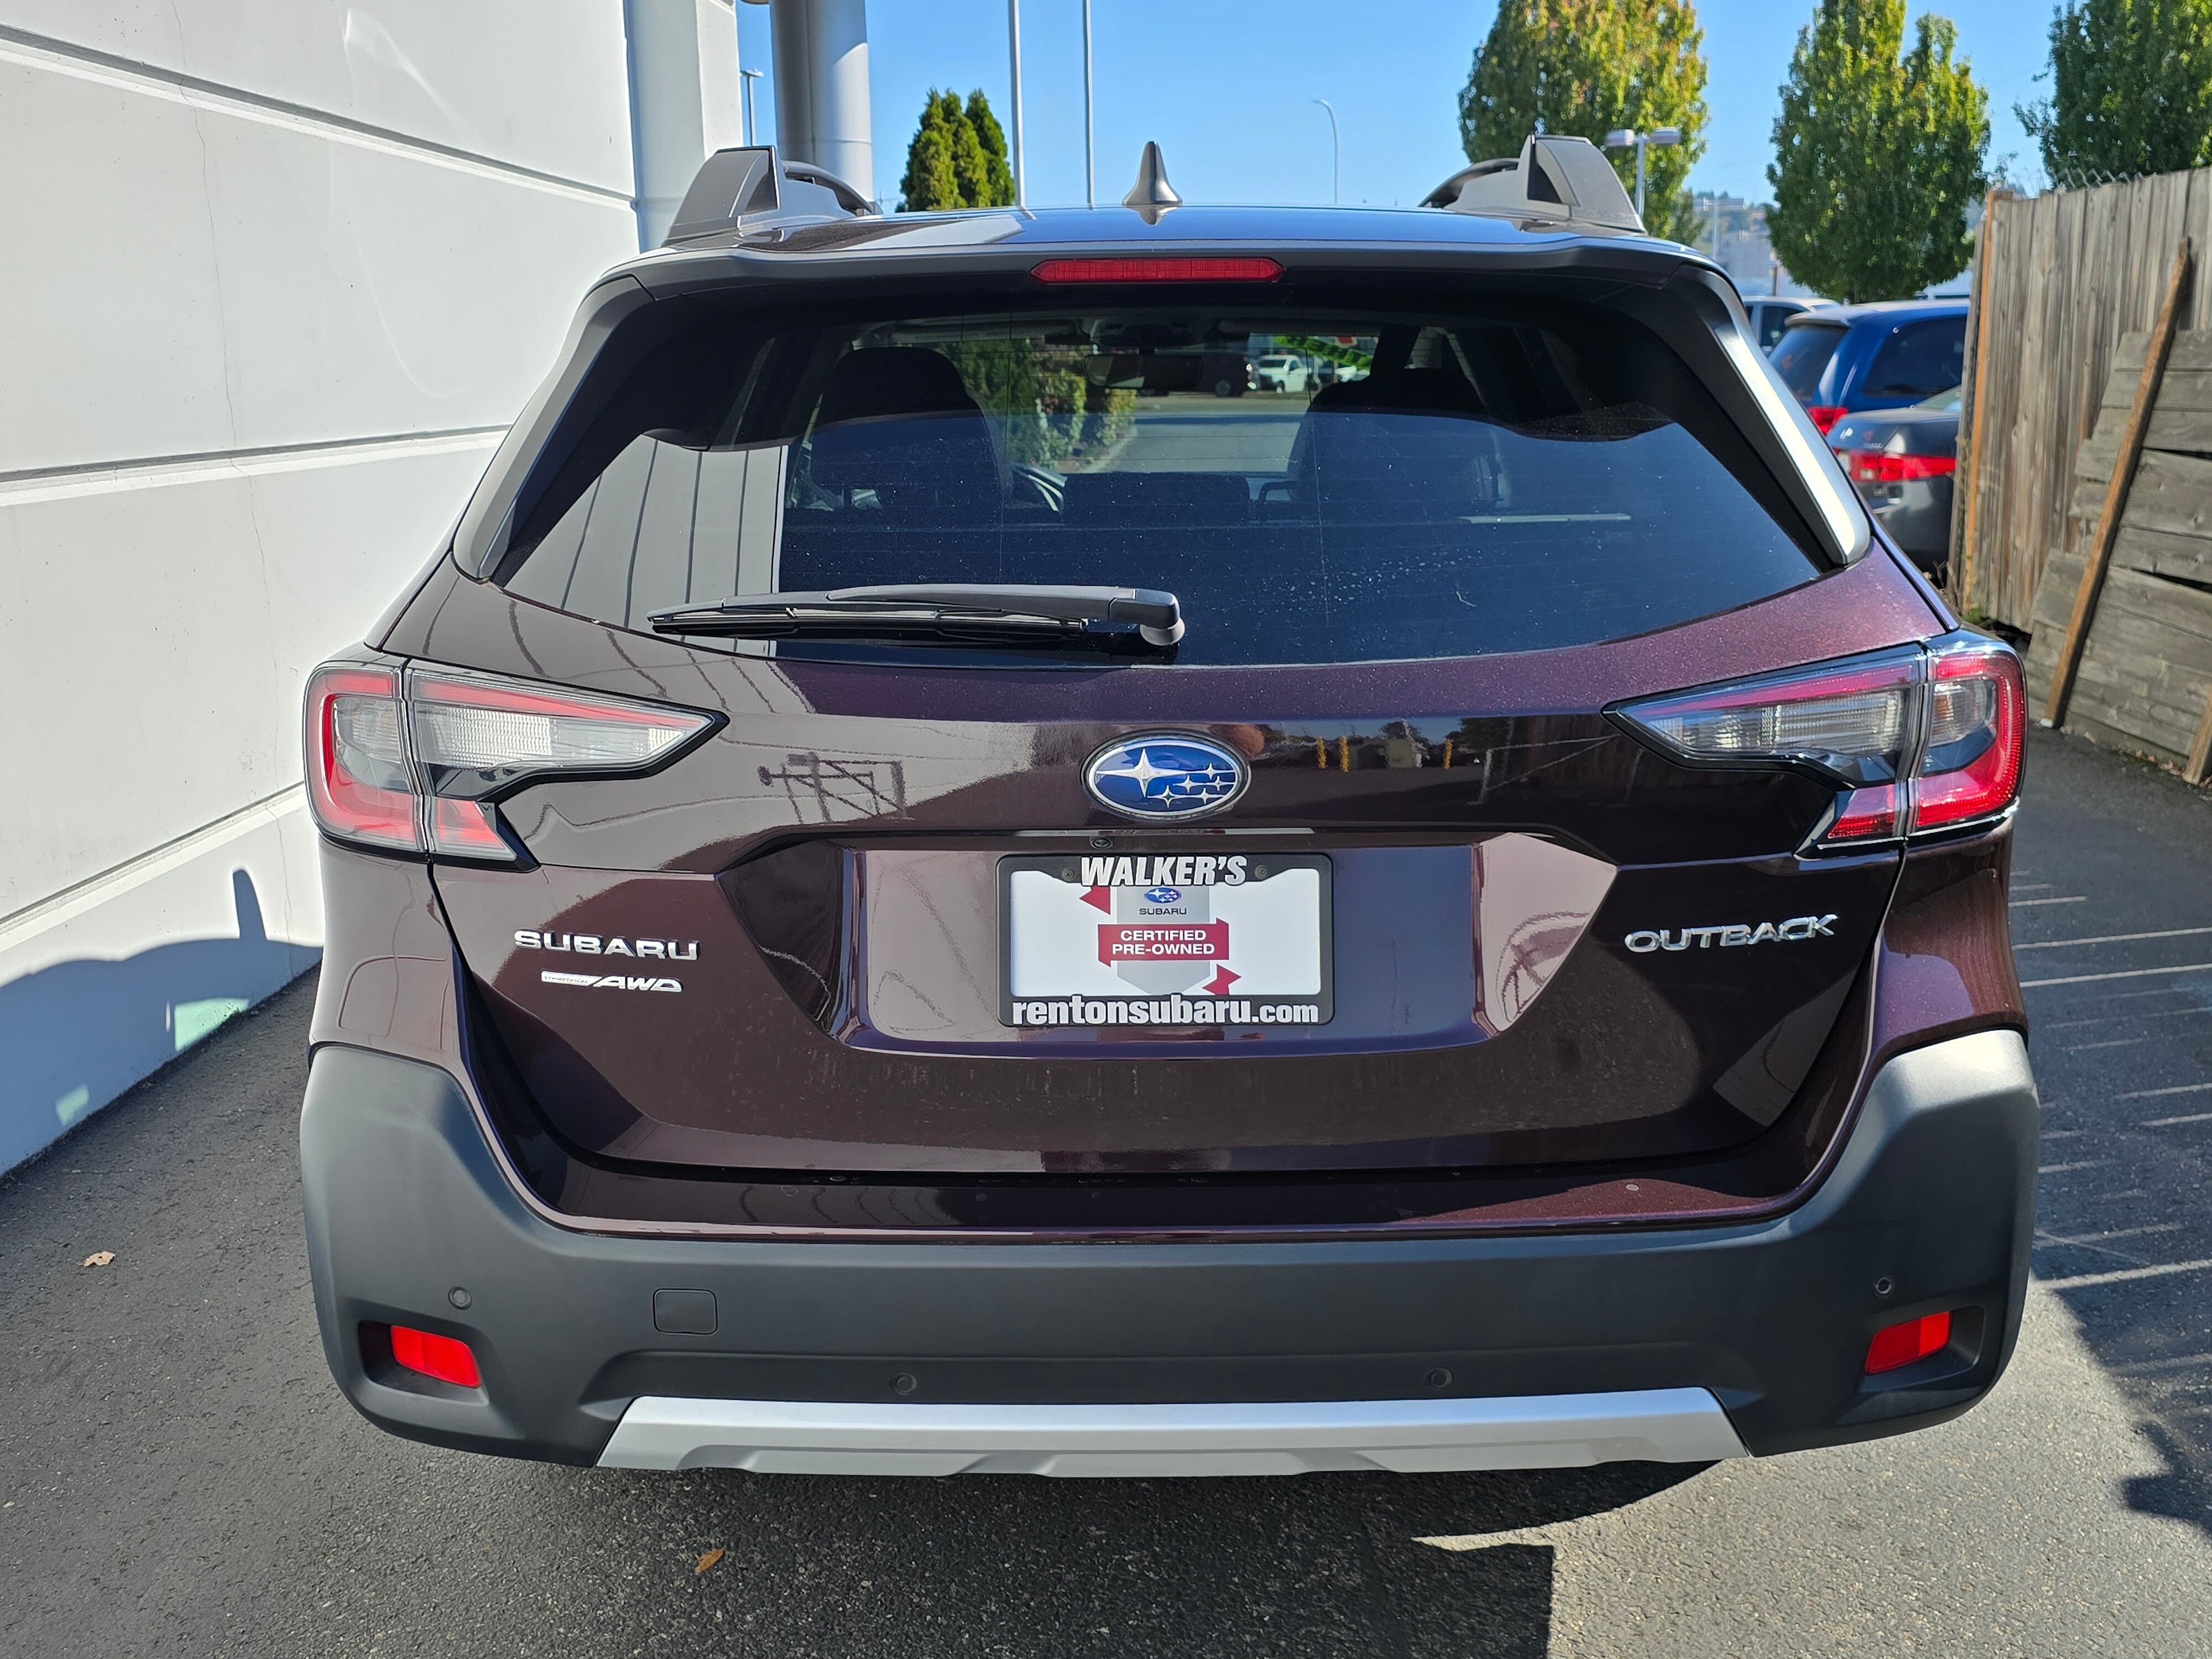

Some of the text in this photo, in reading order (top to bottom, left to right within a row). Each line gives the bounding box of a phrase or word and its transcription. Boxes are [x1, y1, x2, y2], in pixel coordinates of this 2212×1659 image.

[1081, 855, 1247, 887] WALKER'S
[514, 930, 700, 961] SUBARU
[1120, 930, 1207, 941] CERTIFIED
[1624, 914, 1839, 952] OUTBACK
[1112, 943, 1215, 955] PRE-OWNED
[593, 975, 683, 993] AWD
[1012, 994, 1319, 1025] rentonsubaru.com
